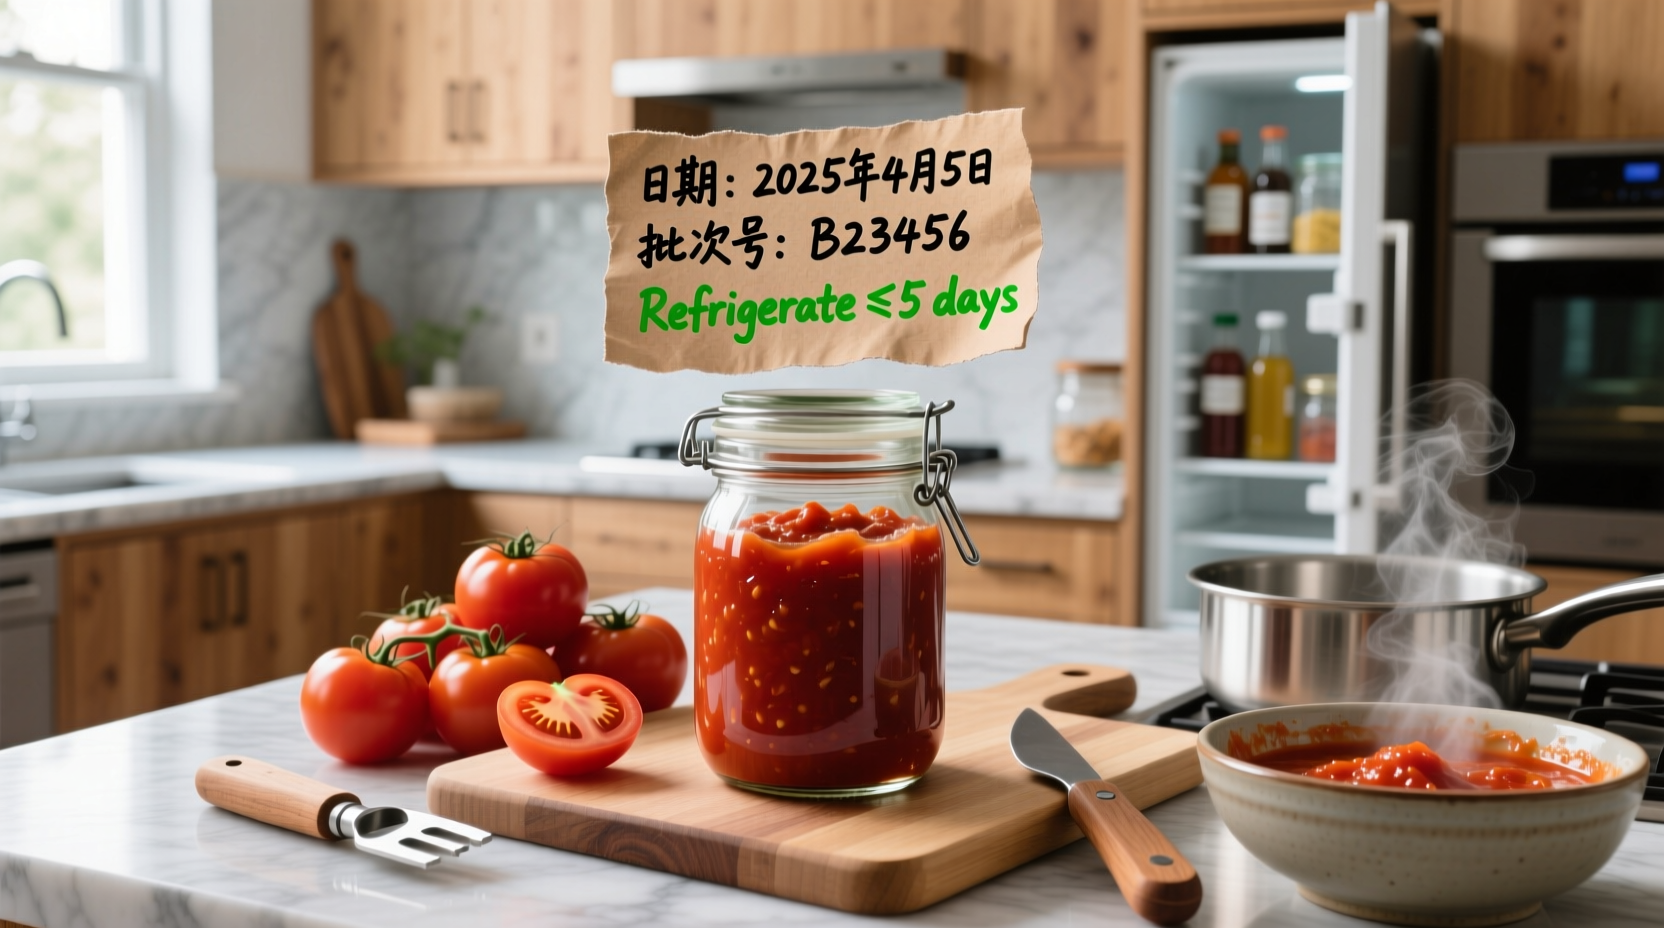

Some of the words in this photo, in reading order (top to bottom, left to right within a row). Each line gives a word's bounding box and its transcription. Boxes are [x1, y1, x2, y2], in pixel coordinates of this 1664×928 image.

[752, 147, 992, 203] 2025年4月5日
[810, 209, 970, 261] B23456
[639, 283, 857, 345] Refrigerate
[932, 274, 1018, 331] days
